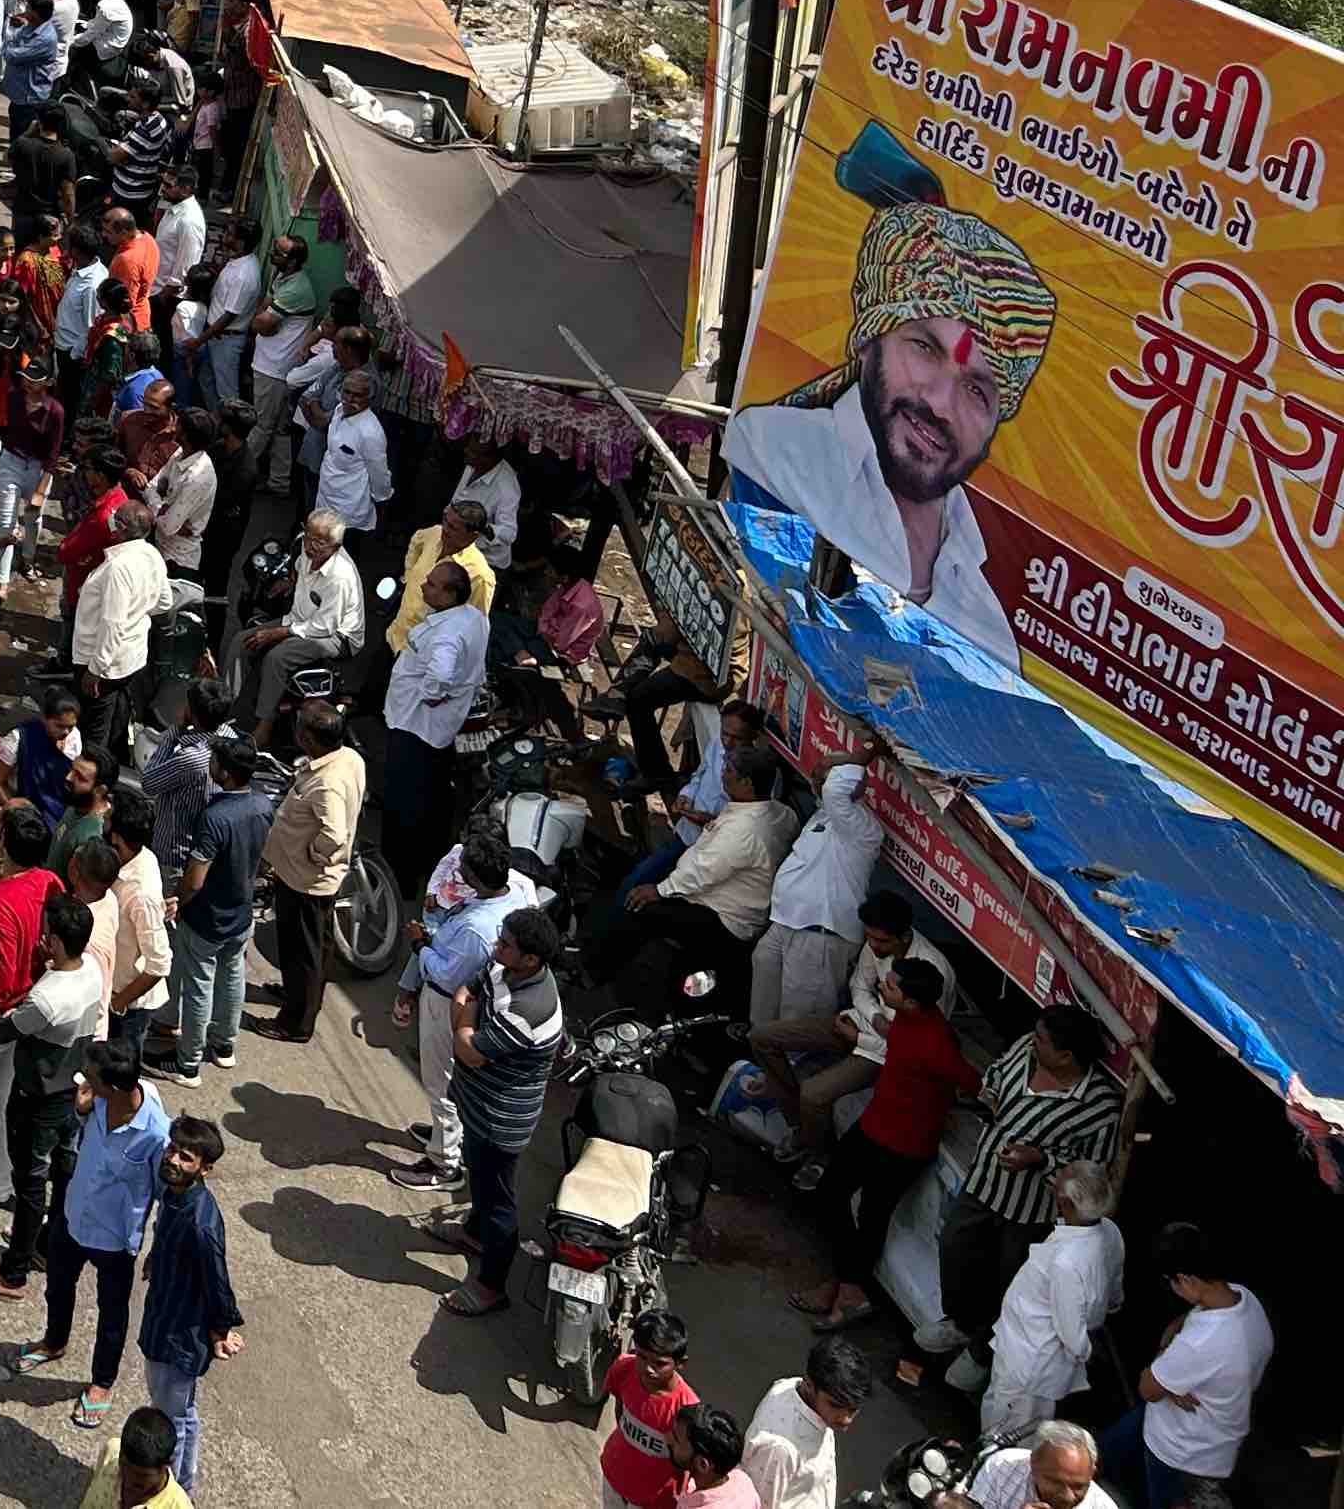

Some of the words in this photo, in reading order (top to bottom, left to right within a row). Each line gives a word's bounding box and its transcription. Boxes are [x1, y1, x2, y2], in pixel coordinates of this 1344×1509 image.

[872, 40, 920, 87] દરેક
[924, 72, 1014, 132] ધર્મપ્રેમી
[1226, 200, 1254, 248] ને
[915, 117, 986, 172] હાર્દિક
[993, 154, 1169, 263] શુભકામનાઓ
[1263, 138, 1317, 203] ની
[1013, 608, 1099, 677] ધારાસભ્ય
[1024, 555, 1069, 611] શ્રી
[1070, 581, 1225, 702] હીરાભાઈ
[622, 1416, 664, 1455] NIKE
